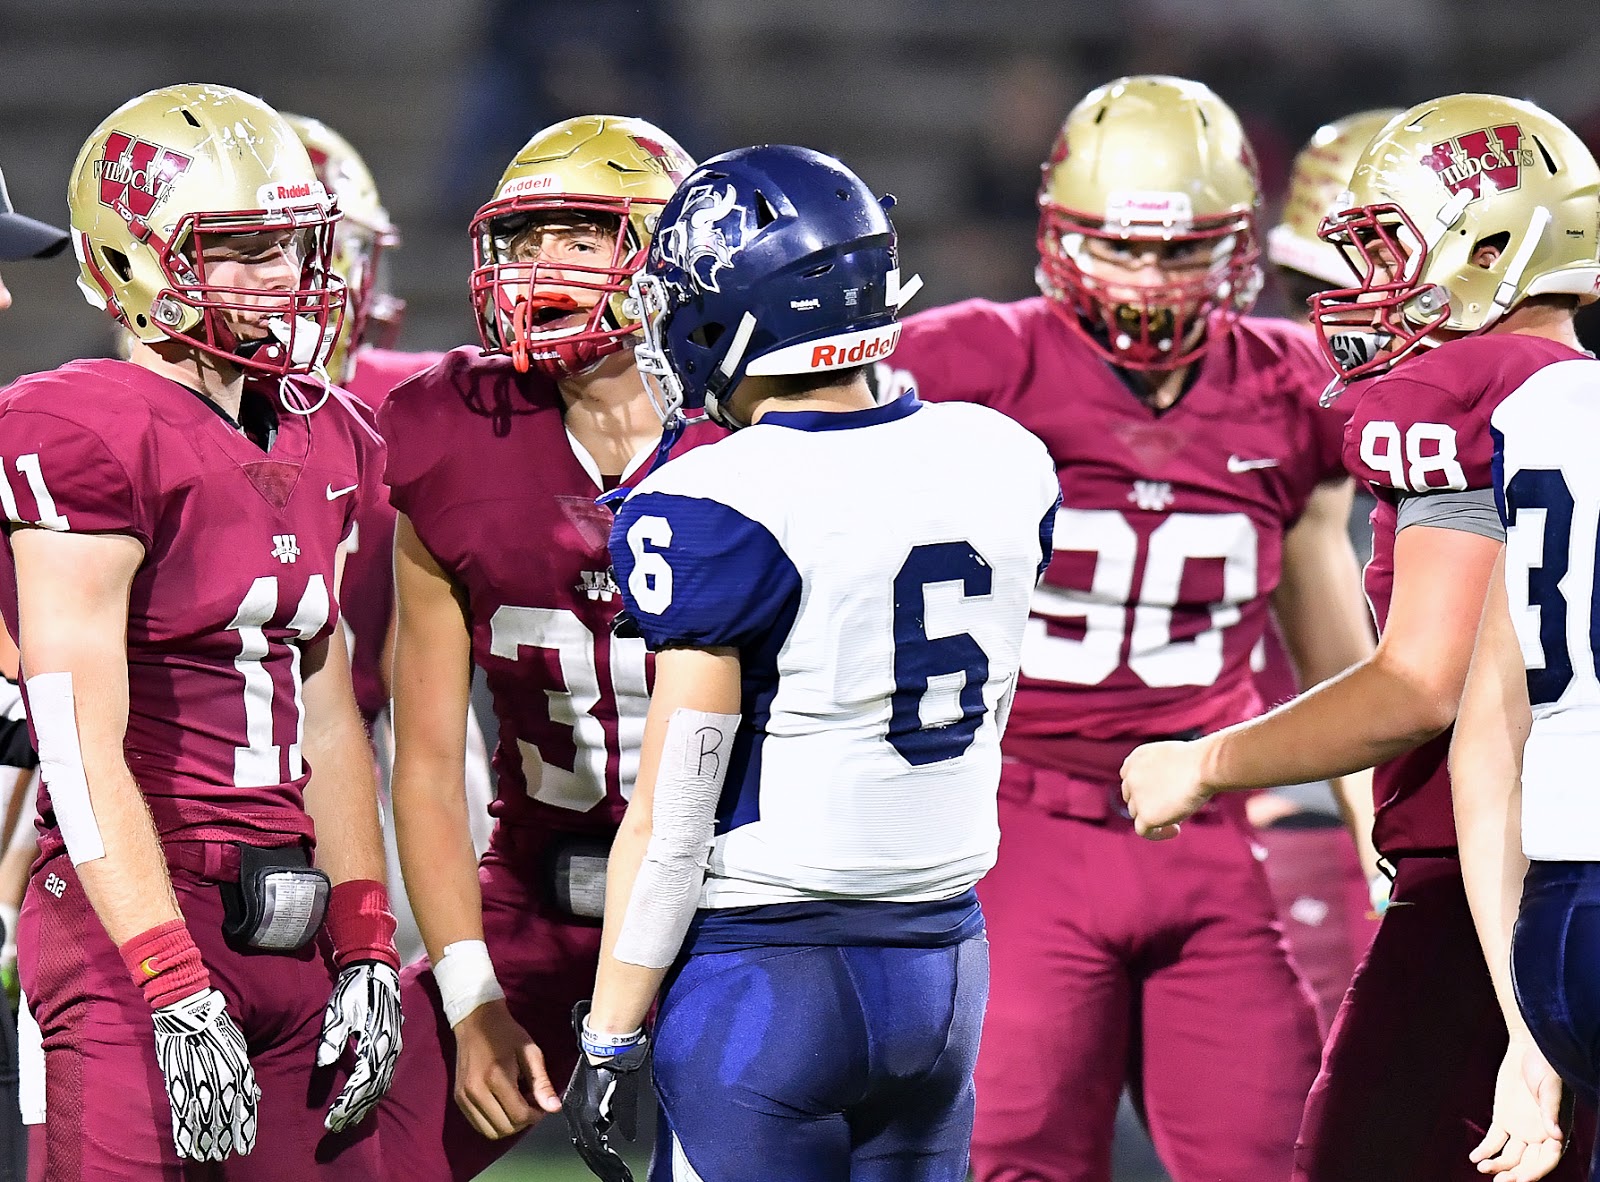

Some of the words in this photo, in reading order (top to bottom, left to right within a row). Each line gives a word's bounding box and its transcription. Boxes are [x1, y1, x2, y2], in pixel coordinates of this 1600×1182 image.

[94, 159, 175, 202] WILDCAT
[98, 129, 194, 221] W
[277, 183, 311, 199] Riddell
[504, 177, 552, 194] Riddell
[811, 329, 900, 368] Riddell
[1360, 420, 1468, 492] 98
[627, 515, 674, 616] 6
[1021, 508, 1258, 688] 90
[1505, 468, 1600, 706] 3
[225, 574, 331, 788] 11
[886, 539, 995, 768] 6
[44, 872, 67, 899] 212
